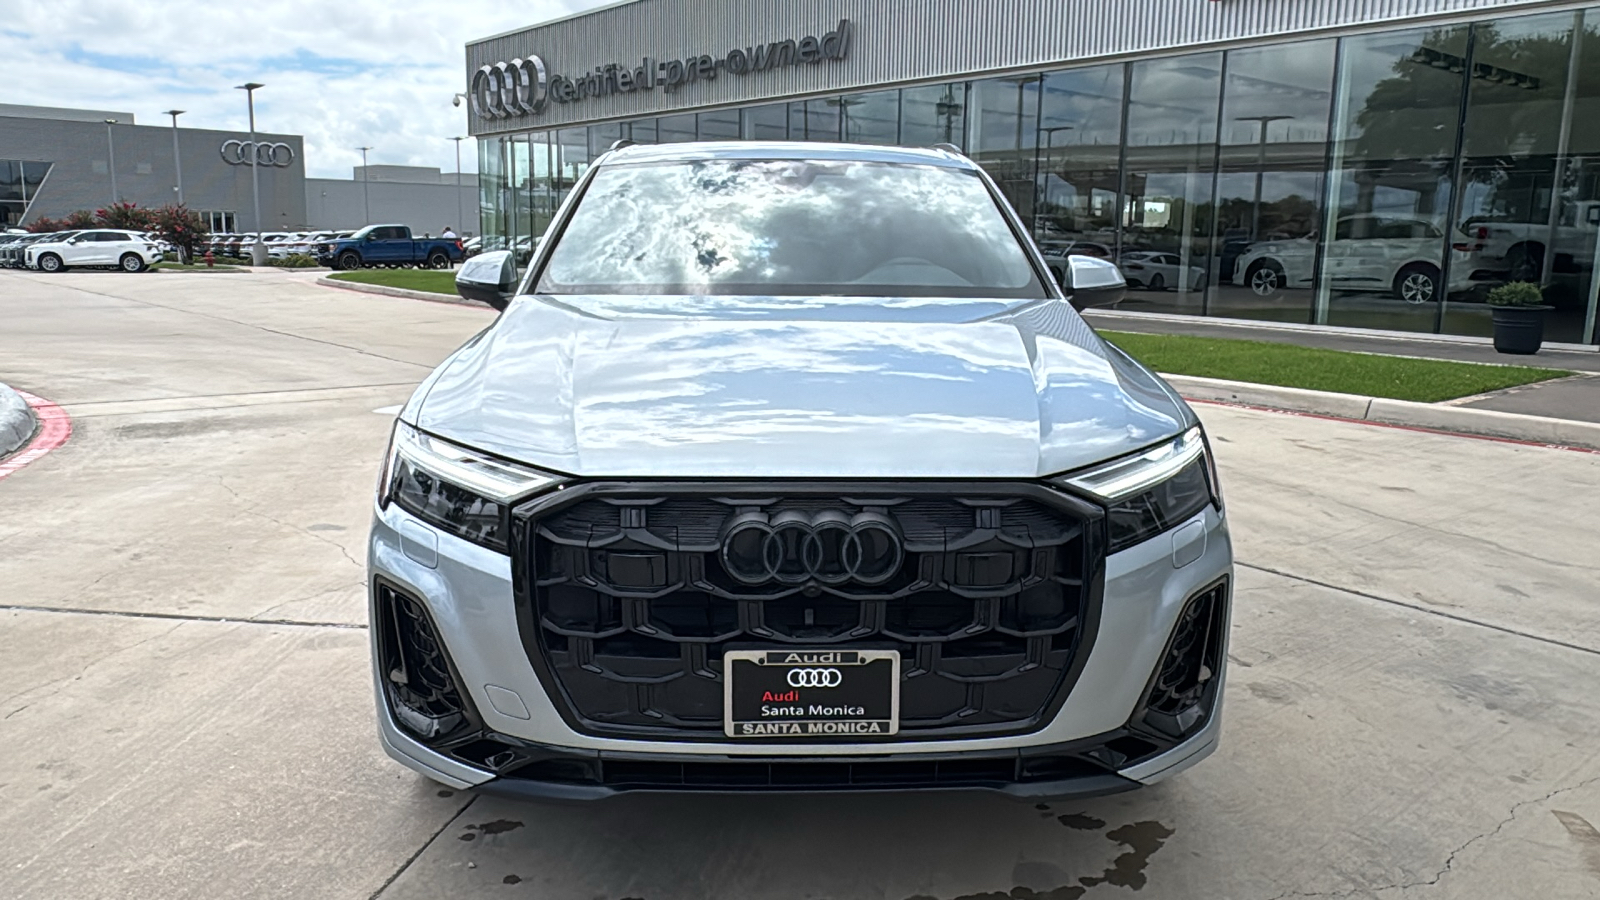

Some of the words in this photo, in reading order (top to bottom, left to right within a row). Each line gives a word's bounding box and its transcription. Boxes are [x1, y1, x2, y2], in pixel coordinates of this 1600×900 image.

[549, 57, 654, 103] Certified
[785, 653, 842, 663] Audi
[762, 691, 799, 701] Audi
[761, 705, 804, 716] Santa
[809, 705, 865, 716] Monica
[742, 723, 801, 734] SANTA
[808, 722, 881, 733] MONICA
